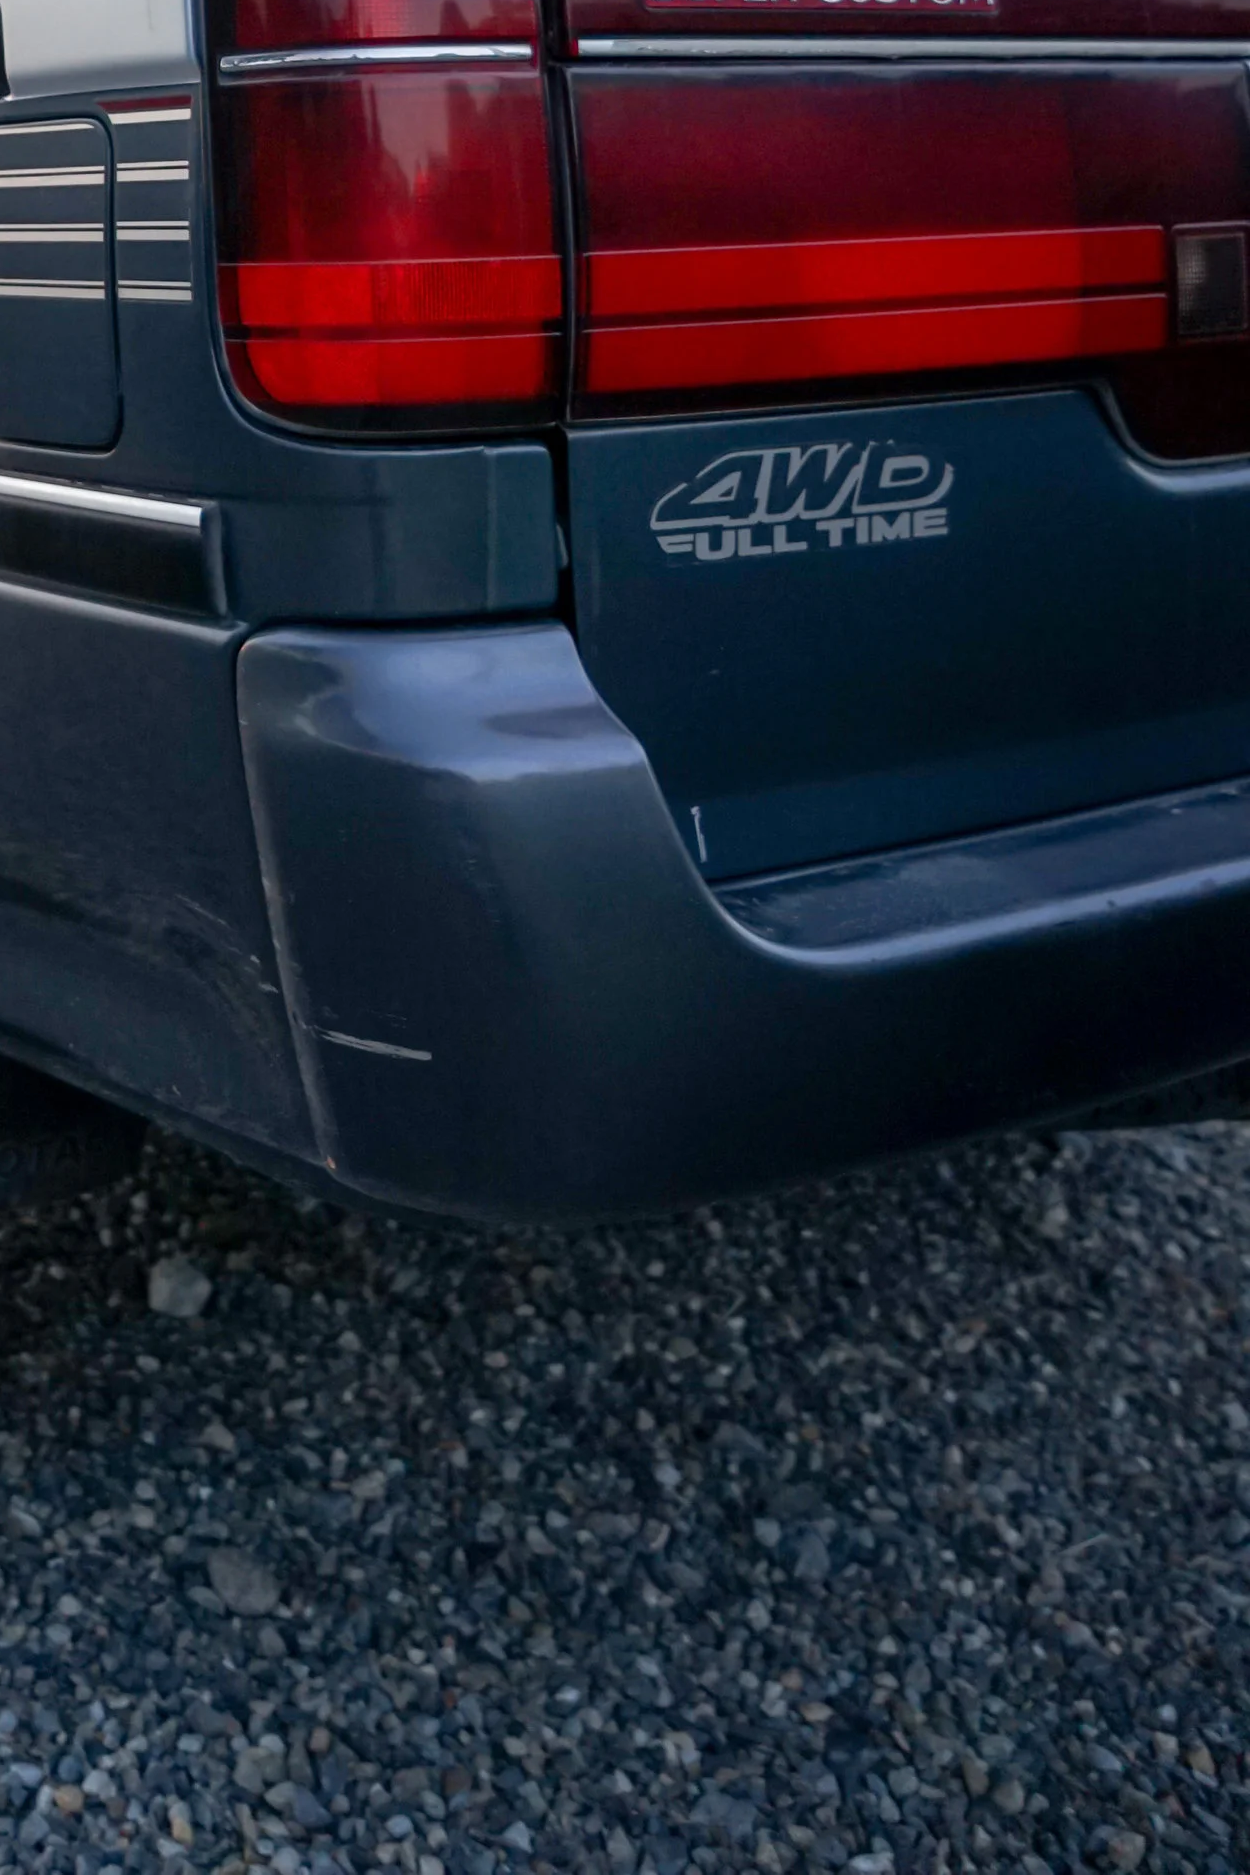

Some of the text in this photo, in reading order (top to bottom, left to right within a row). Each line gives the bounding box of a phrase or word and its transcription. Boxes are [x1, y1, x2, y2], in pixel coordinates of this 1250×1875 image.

[650, 439, 955, 530] 4WD
[657, 507, 949, 561] FULL TIME
